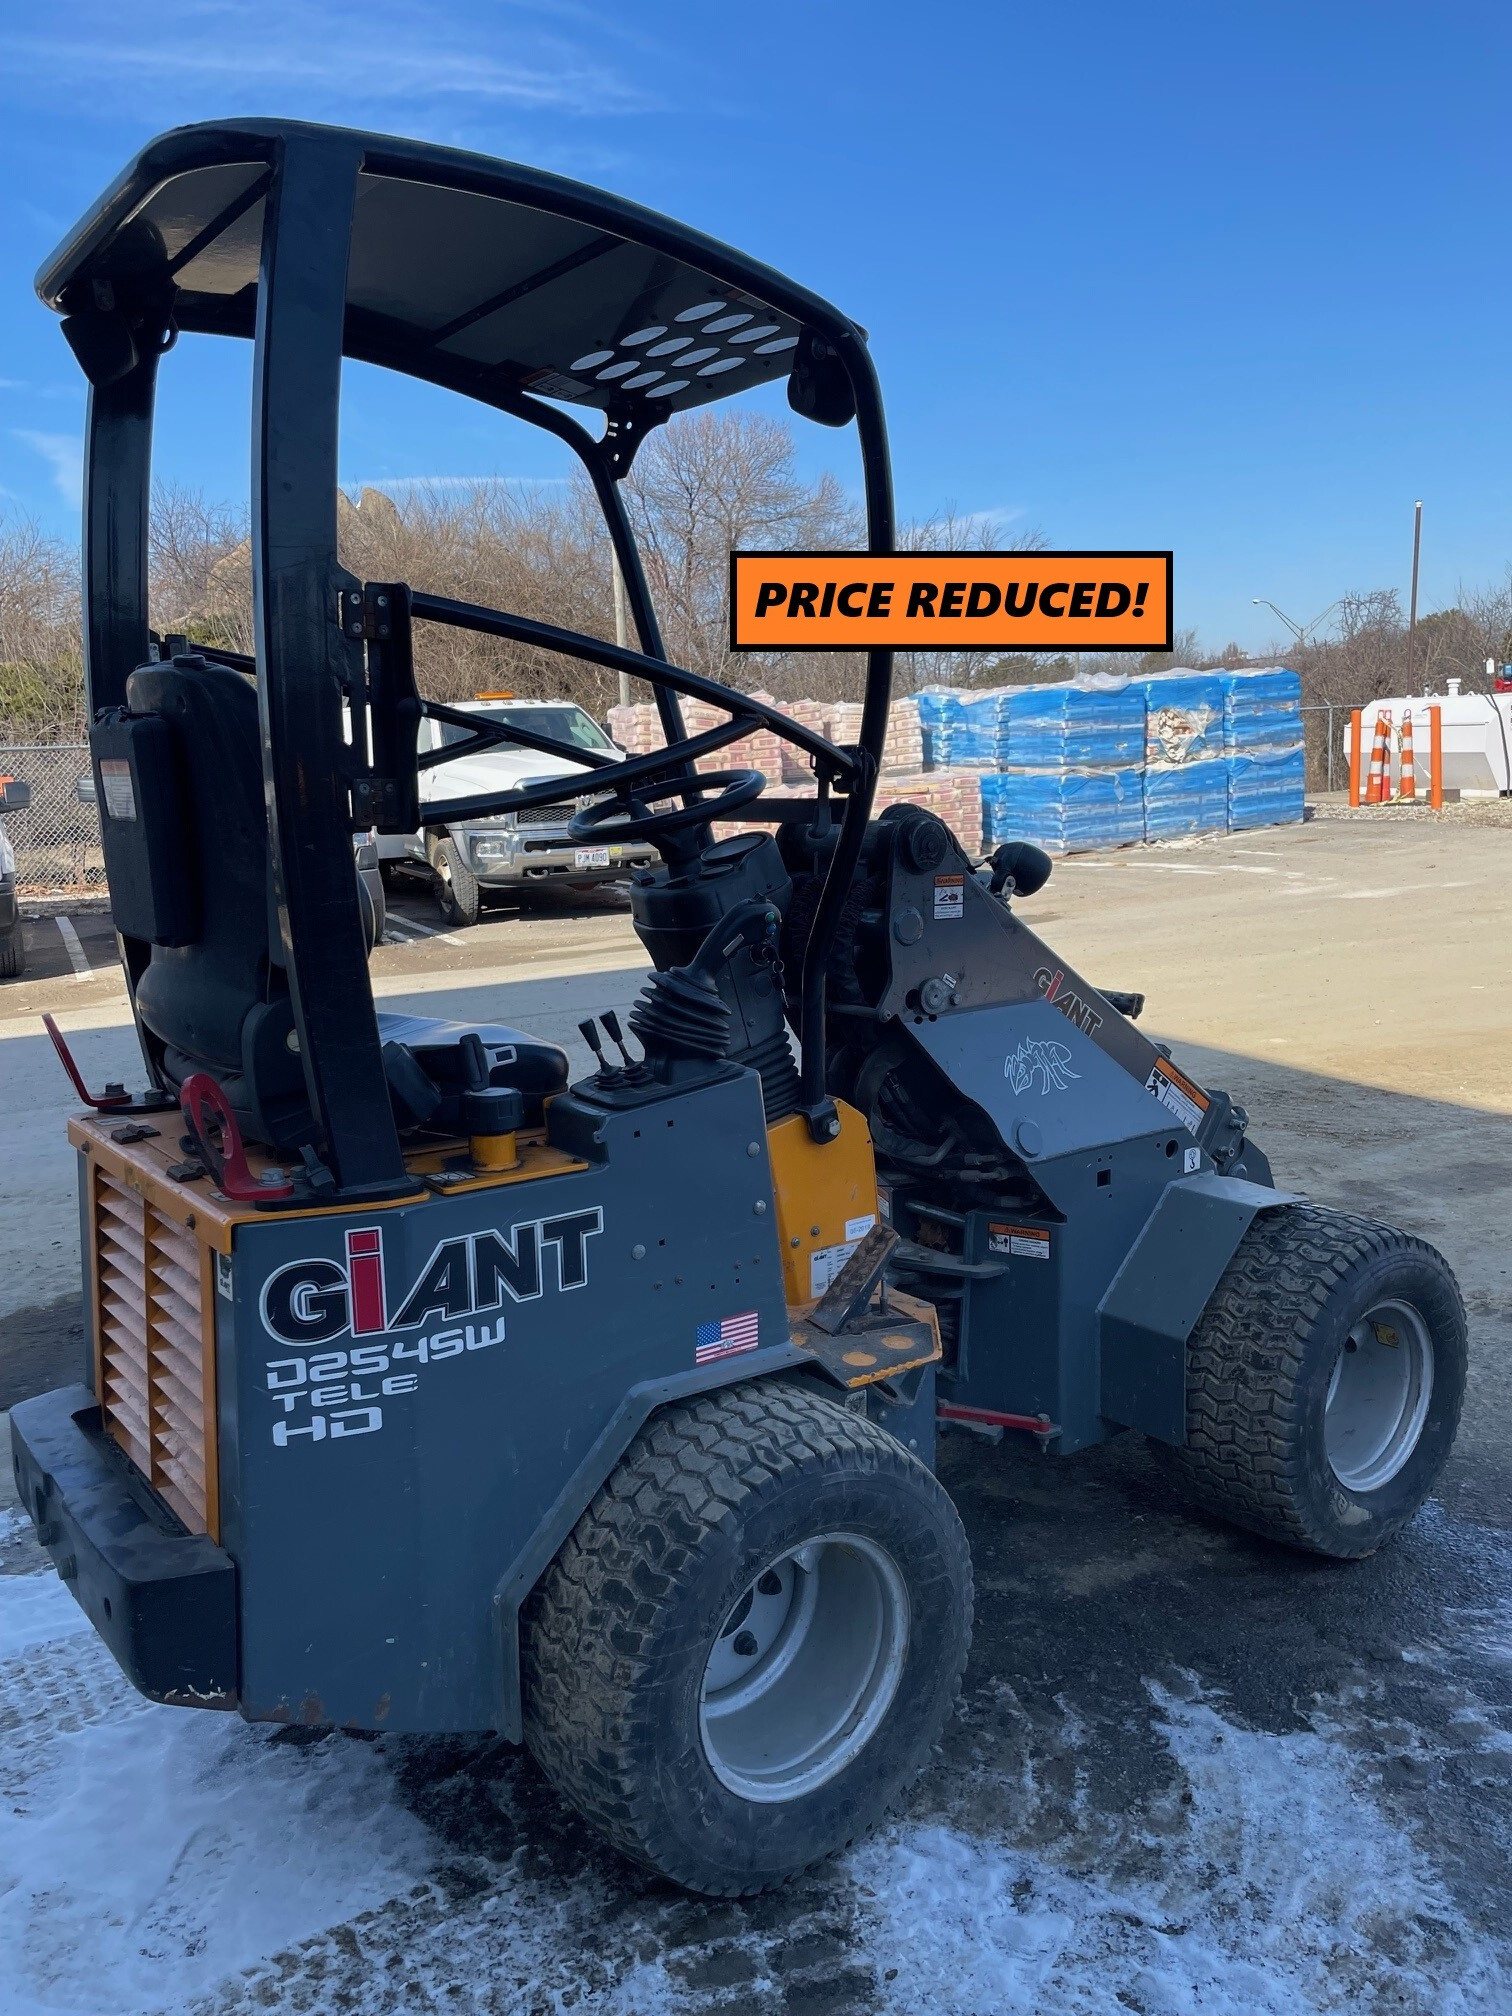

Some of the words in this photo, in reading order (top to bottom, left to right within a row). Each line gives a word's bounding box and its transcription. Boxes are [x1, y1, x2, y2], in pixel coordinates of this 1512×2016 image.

[1173, 1074, 1197, 1099] WARNING
[1010, 1228, 1041, 1238] WARNING
[266, 1316, 506, 1390] D254SW
[272, 1373, 419, 1413] TELE
[272, 1406, 383, 1447] HD
